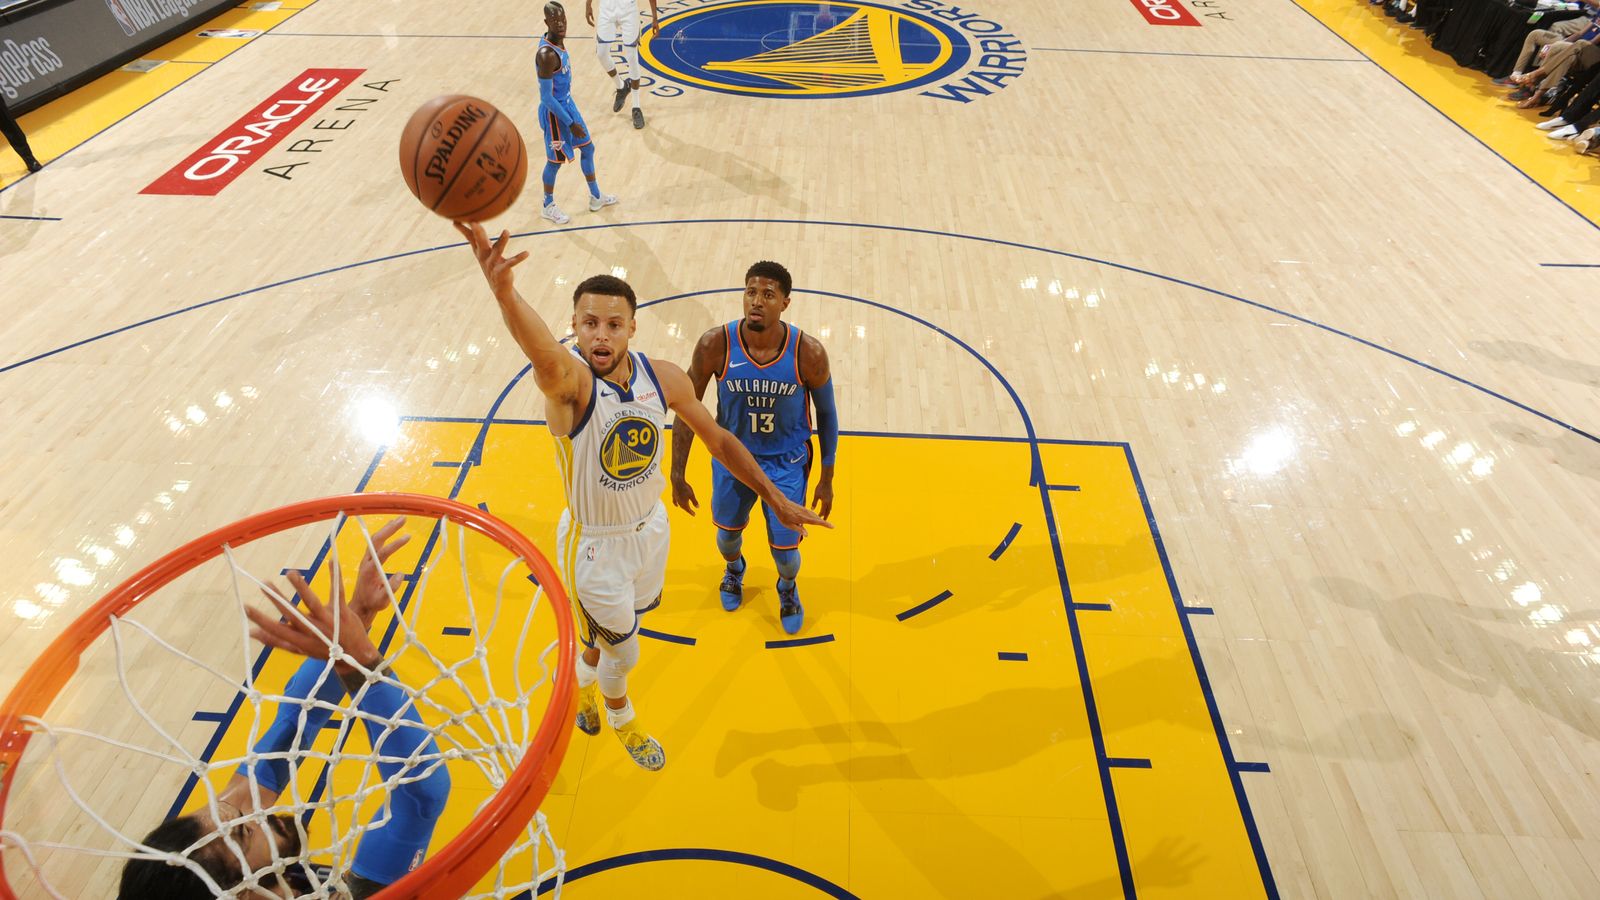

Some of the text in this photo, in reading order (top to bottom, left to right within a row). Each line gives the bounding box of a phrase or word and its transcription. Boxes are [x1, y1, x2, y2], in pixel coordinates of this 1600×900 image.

[917, 0, 1027, 104] WARRIORS
[183, 77, 340, 180] ORACLE
[263, 78, 401, 180] ARENA
[424, 104, 486, 185] SPALDING
[726, 379, 798, 396] OKLAHOMA
[747, 395, 776, 408] CITY
[601, 409, 635, 435] GOLDEN
[748, 412, 775, 433] 13
[627, 427, 652, 447] 30
[599, 462, 657, 492] WARRIORS
